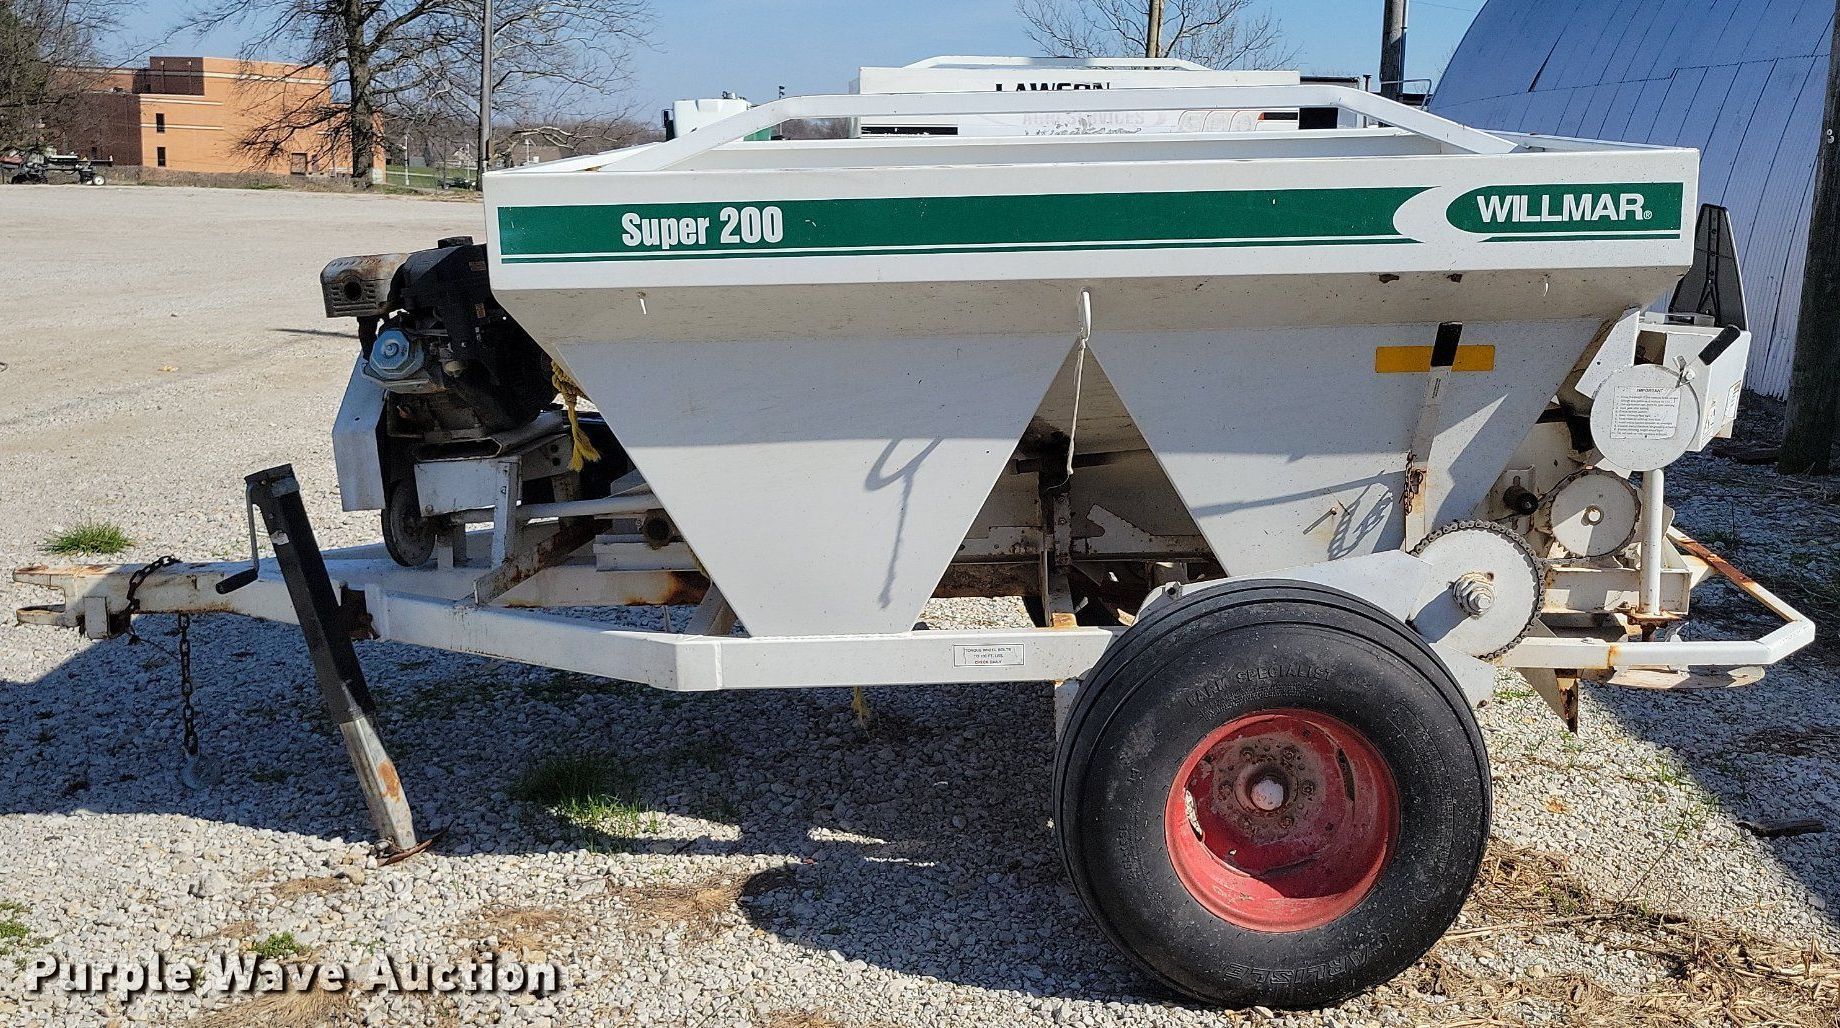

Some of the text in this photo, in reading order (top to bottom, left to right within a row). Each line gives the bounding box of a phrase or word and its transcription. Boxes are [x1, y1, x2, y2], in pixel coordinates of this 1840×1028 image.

[621, 206, 784, 249] Super 200
[1236, 664, 1332, 684] SPECIALIST
